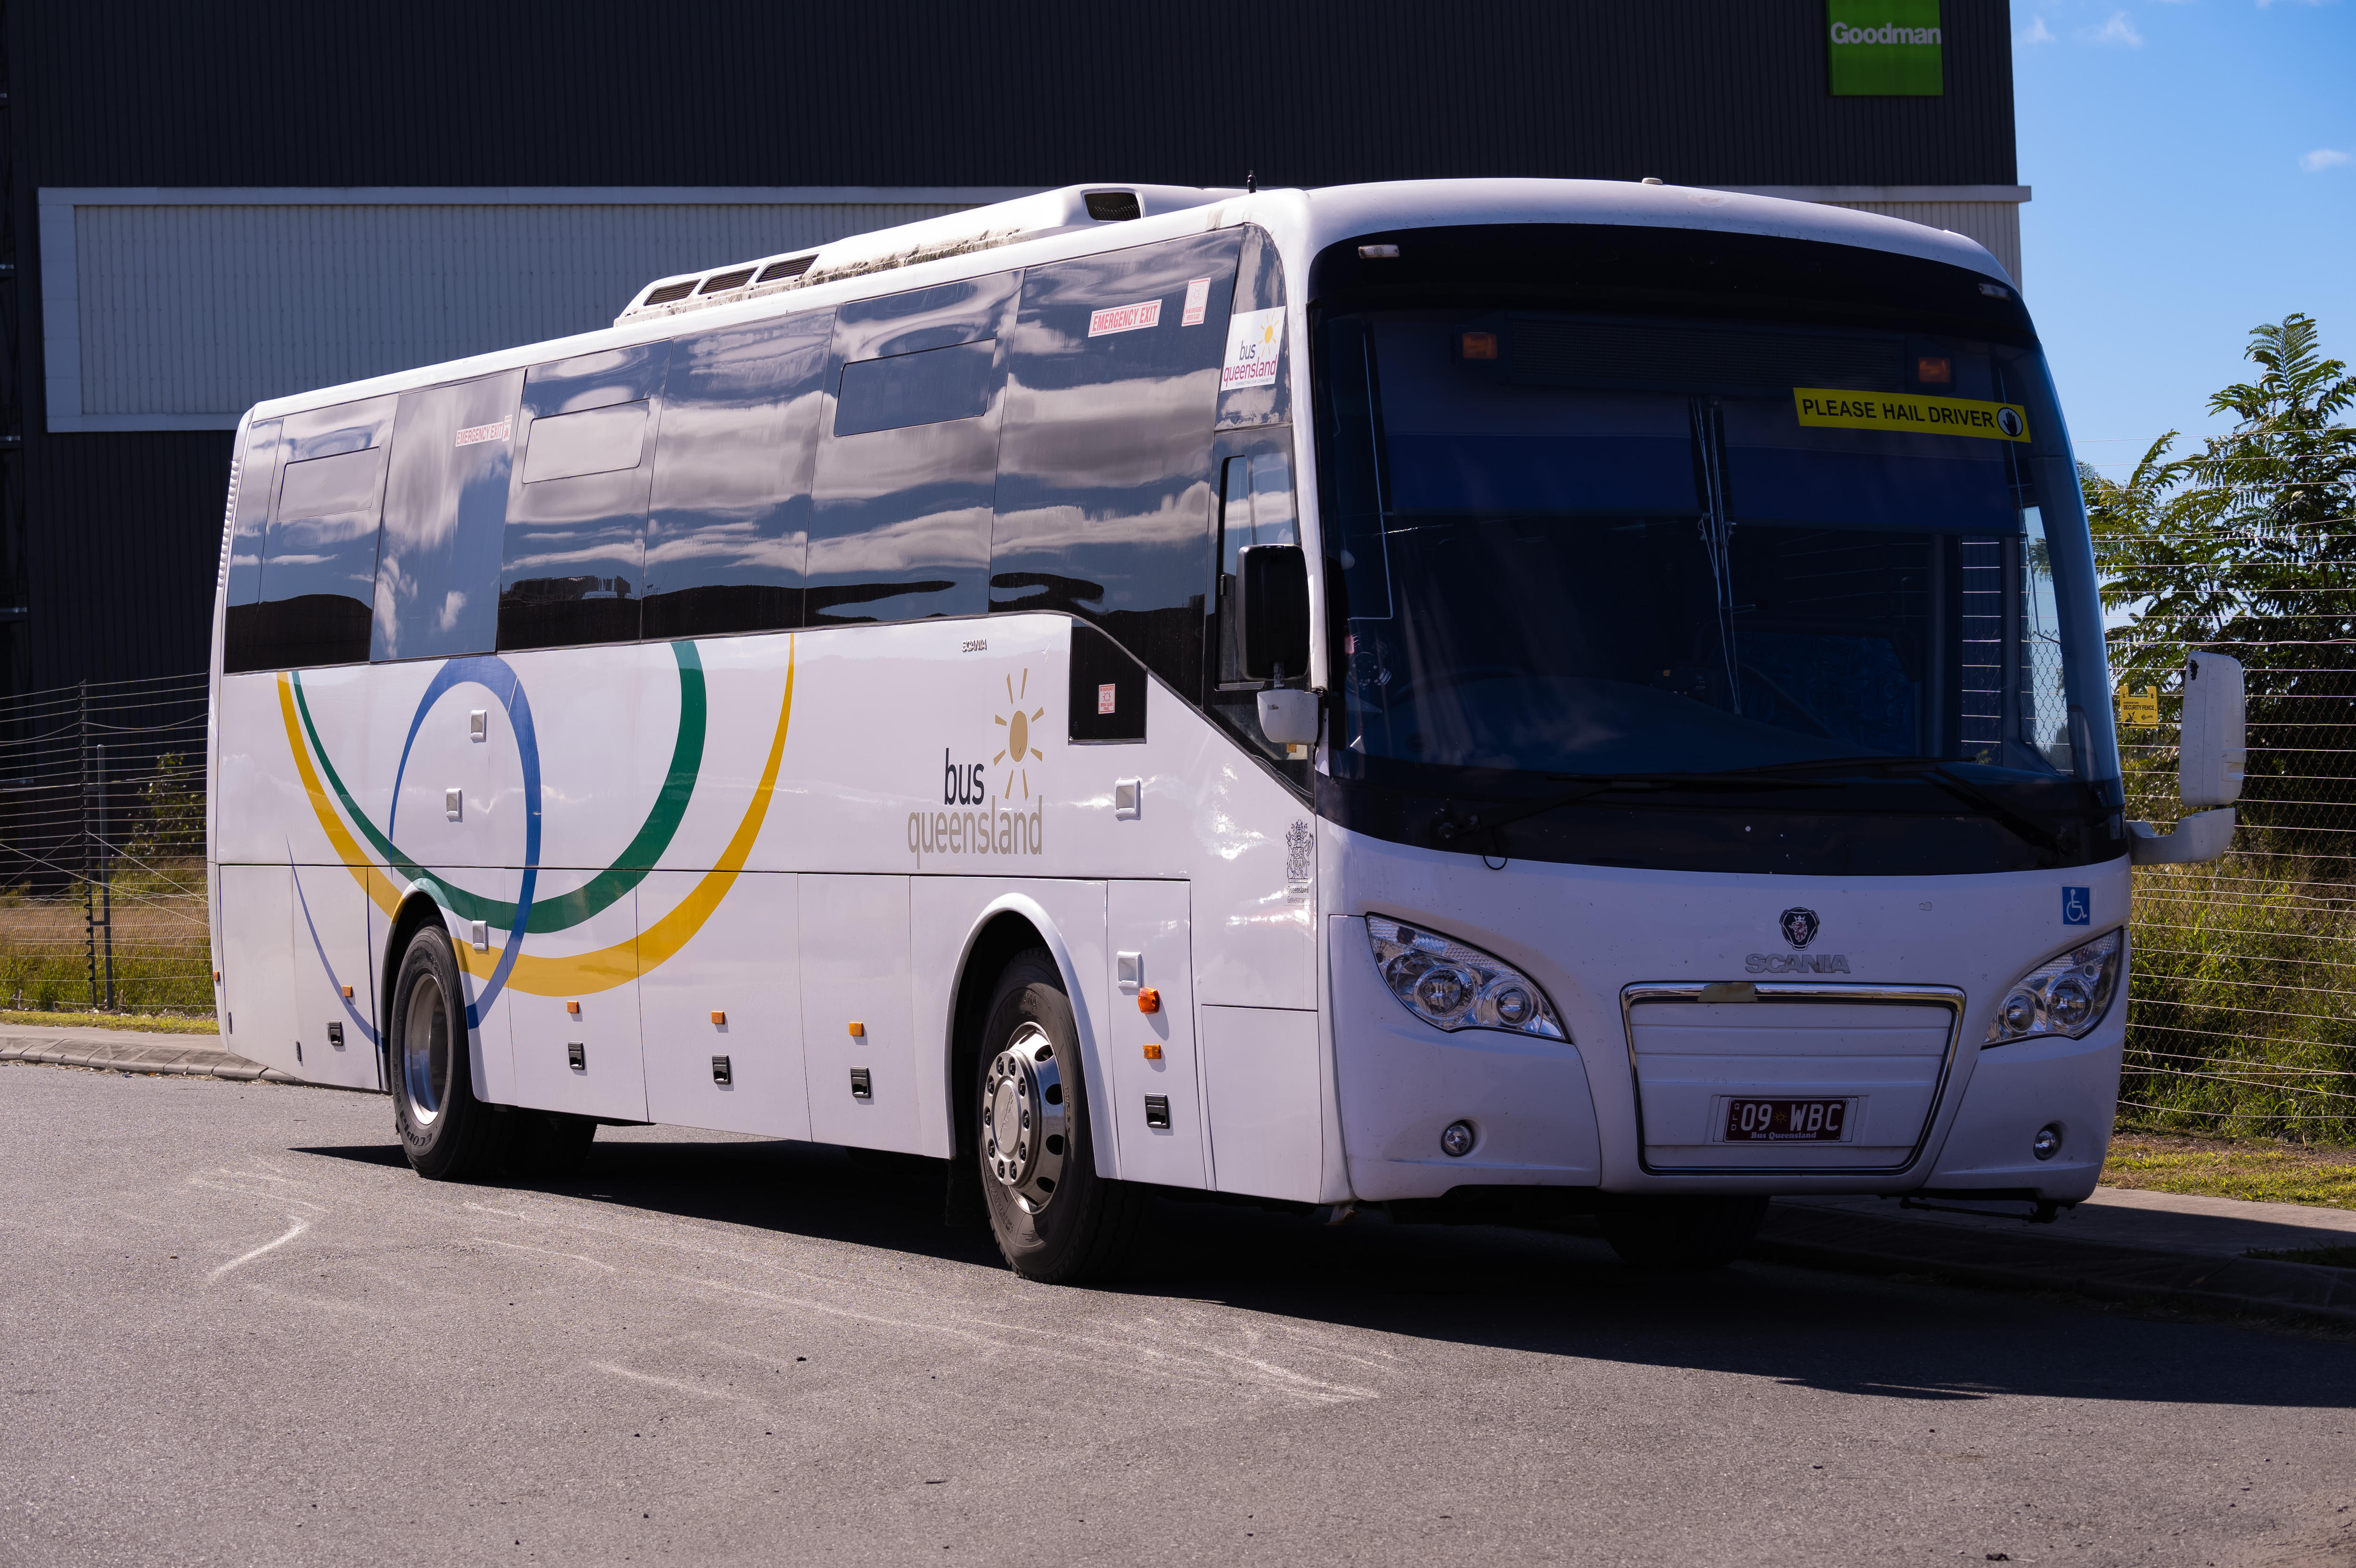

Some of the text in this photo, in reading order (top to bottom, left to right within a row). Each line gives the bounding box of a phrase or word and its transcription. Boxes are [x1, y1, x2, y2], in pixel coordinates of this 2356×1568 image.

[1830, 22, 1942, 44] Goodman
[1092, 305, 1158, 332] EMERGENCY EXIT
[1239, 340, 1256, 361] bus
[1224, 354, 1277, 388] queensland
[1802, 399, 1995, 428] PLEASE HAIL DRIVER
[456, 424, 503, 445] EMERGENCY EXIT
[962, 638, 987, 653] SCANIA
[944, 748, 984, 805] bus
[908, 795, 1042, 870] queensland
[1287, 886, 1309, 894] Queensland
[1745, 953, 1850, 974] SCANIA
[1741, 1103, 1842, 1131] 09 WBC
[1768, 1132, 1816, 1140] Queensland
